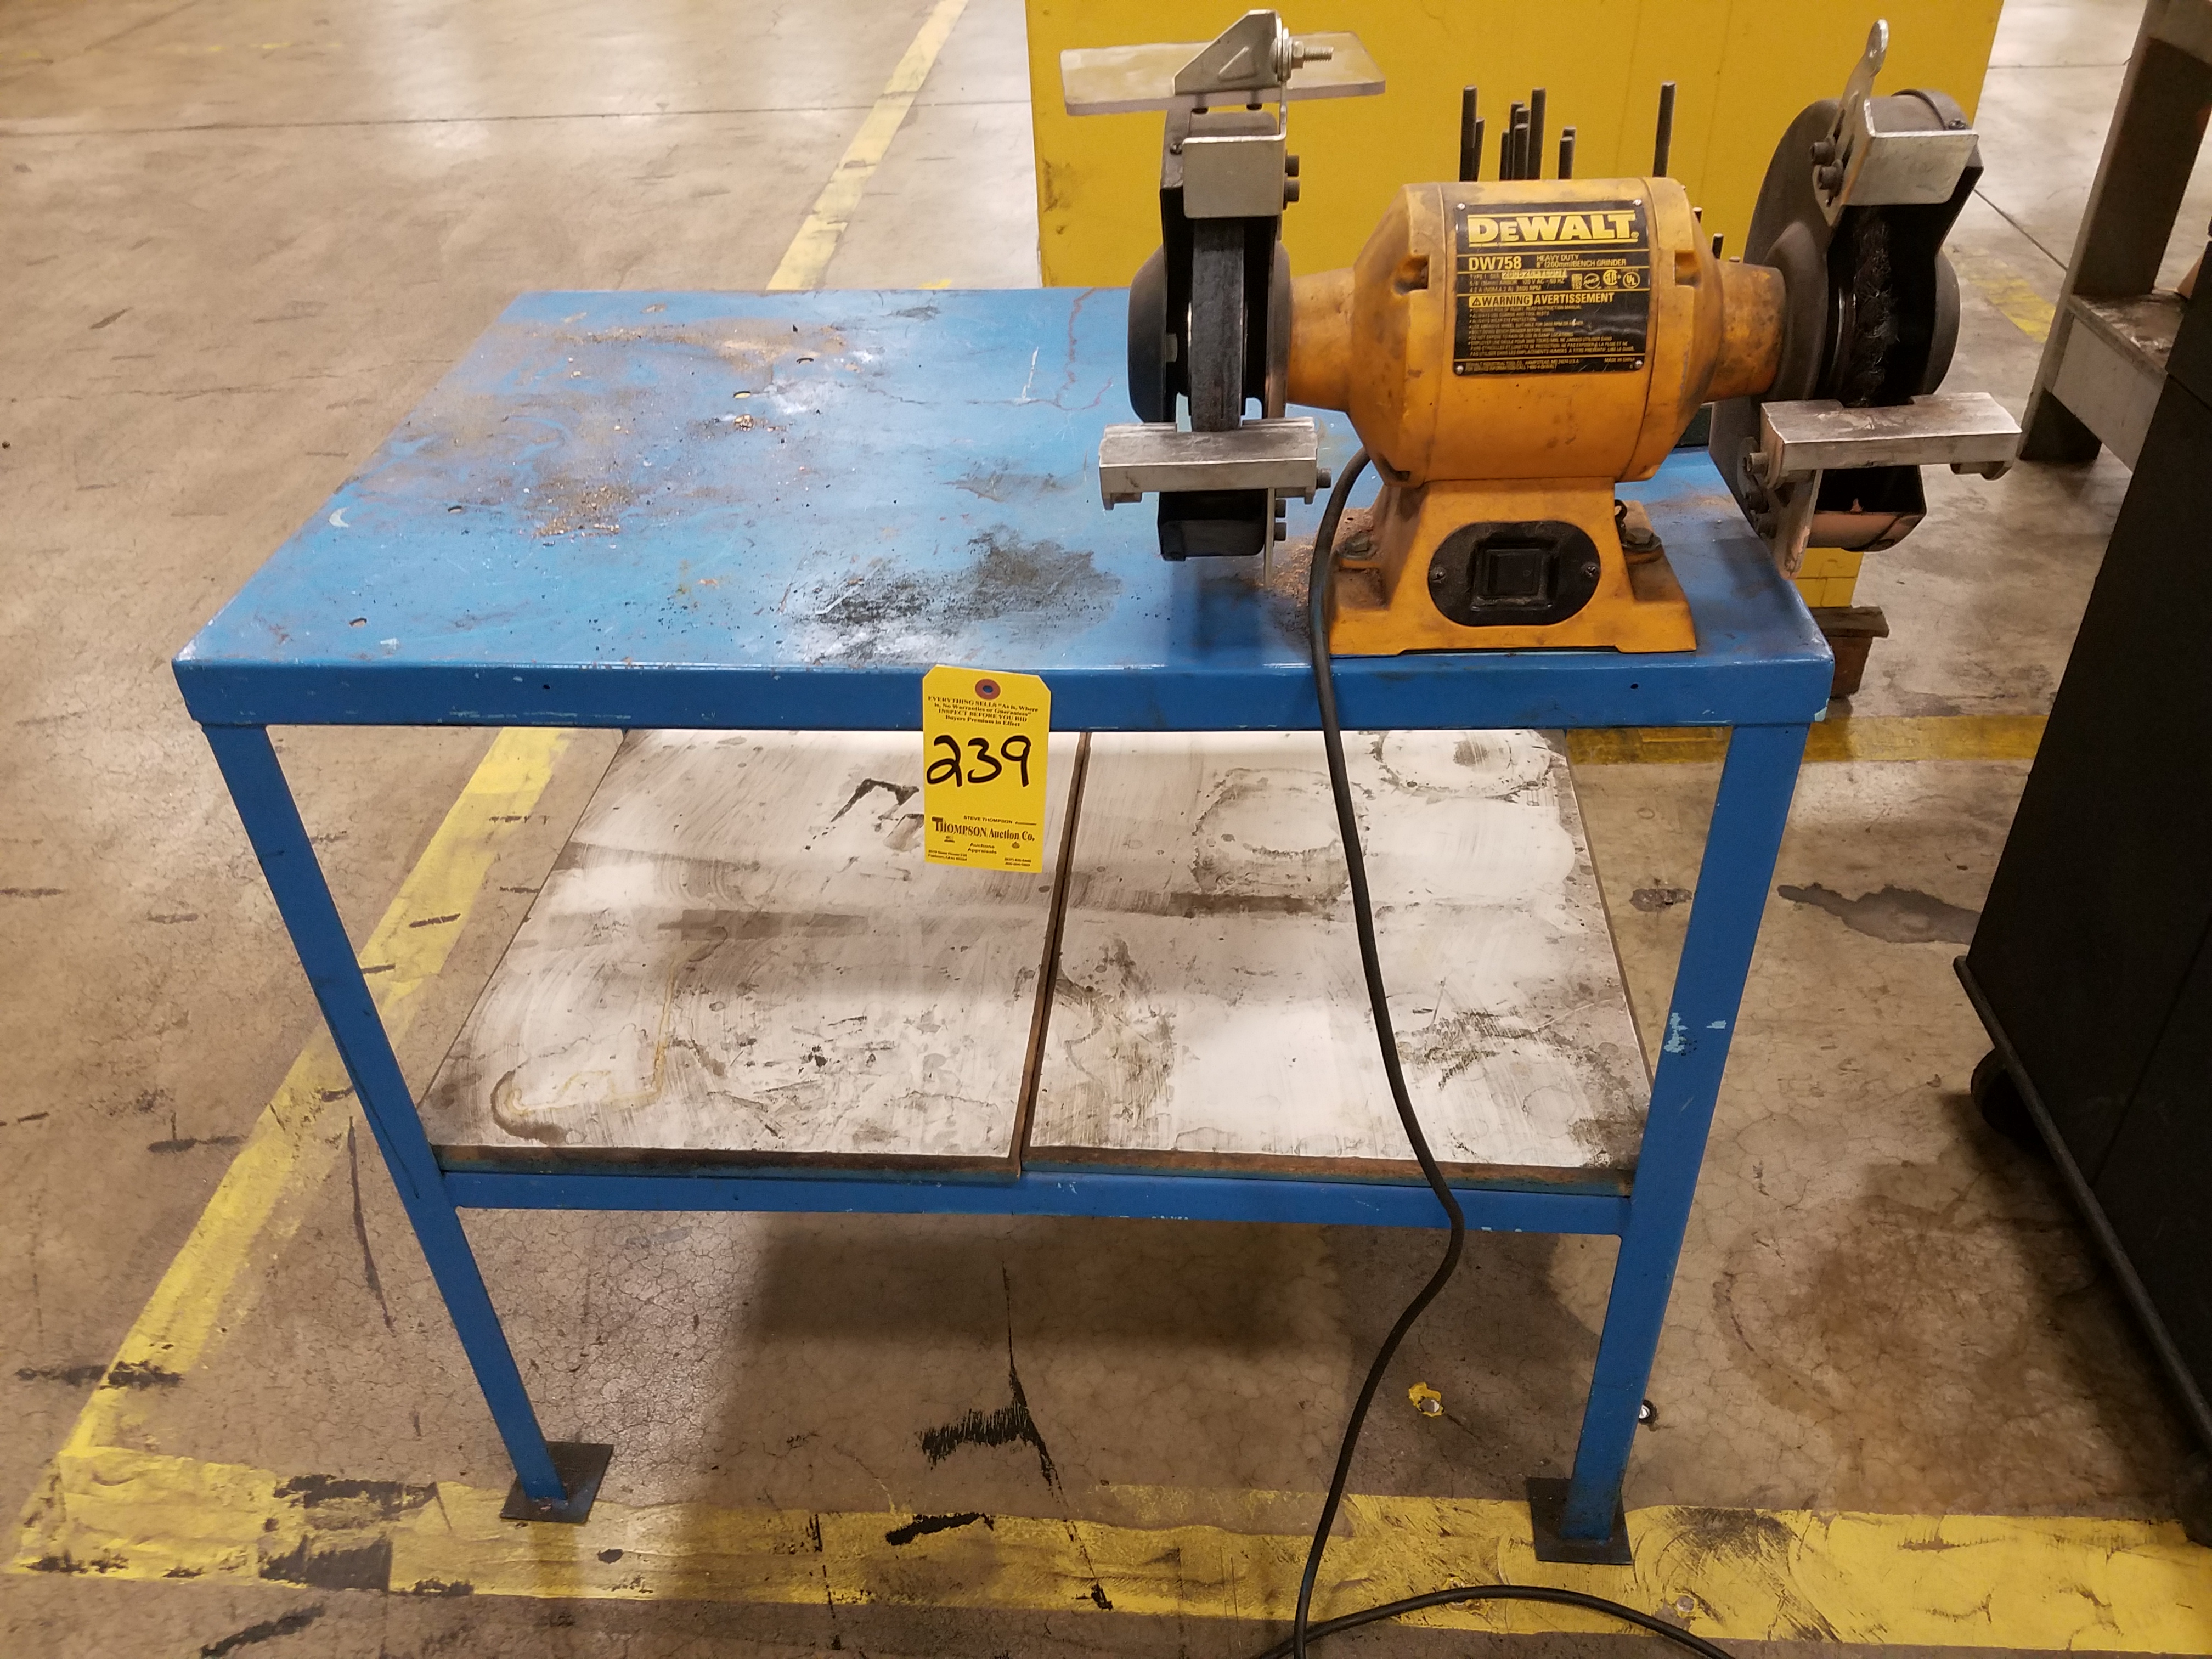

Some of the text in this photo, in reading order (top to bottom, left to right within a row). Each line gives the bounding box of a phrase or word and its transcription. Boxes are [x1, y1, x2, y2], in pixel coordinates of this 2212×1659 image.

[1469, 256, 1522, 271] DW758
[1482, 292, 1615, 306] WARNING AVERTISSEMENT
[928, 696, 974, 705] EVERYTHING
[927, 735, 1031, 787] 239
[932, 816, 986, 837] THOMPSON
[989, 828, 1019, 840] Auction
